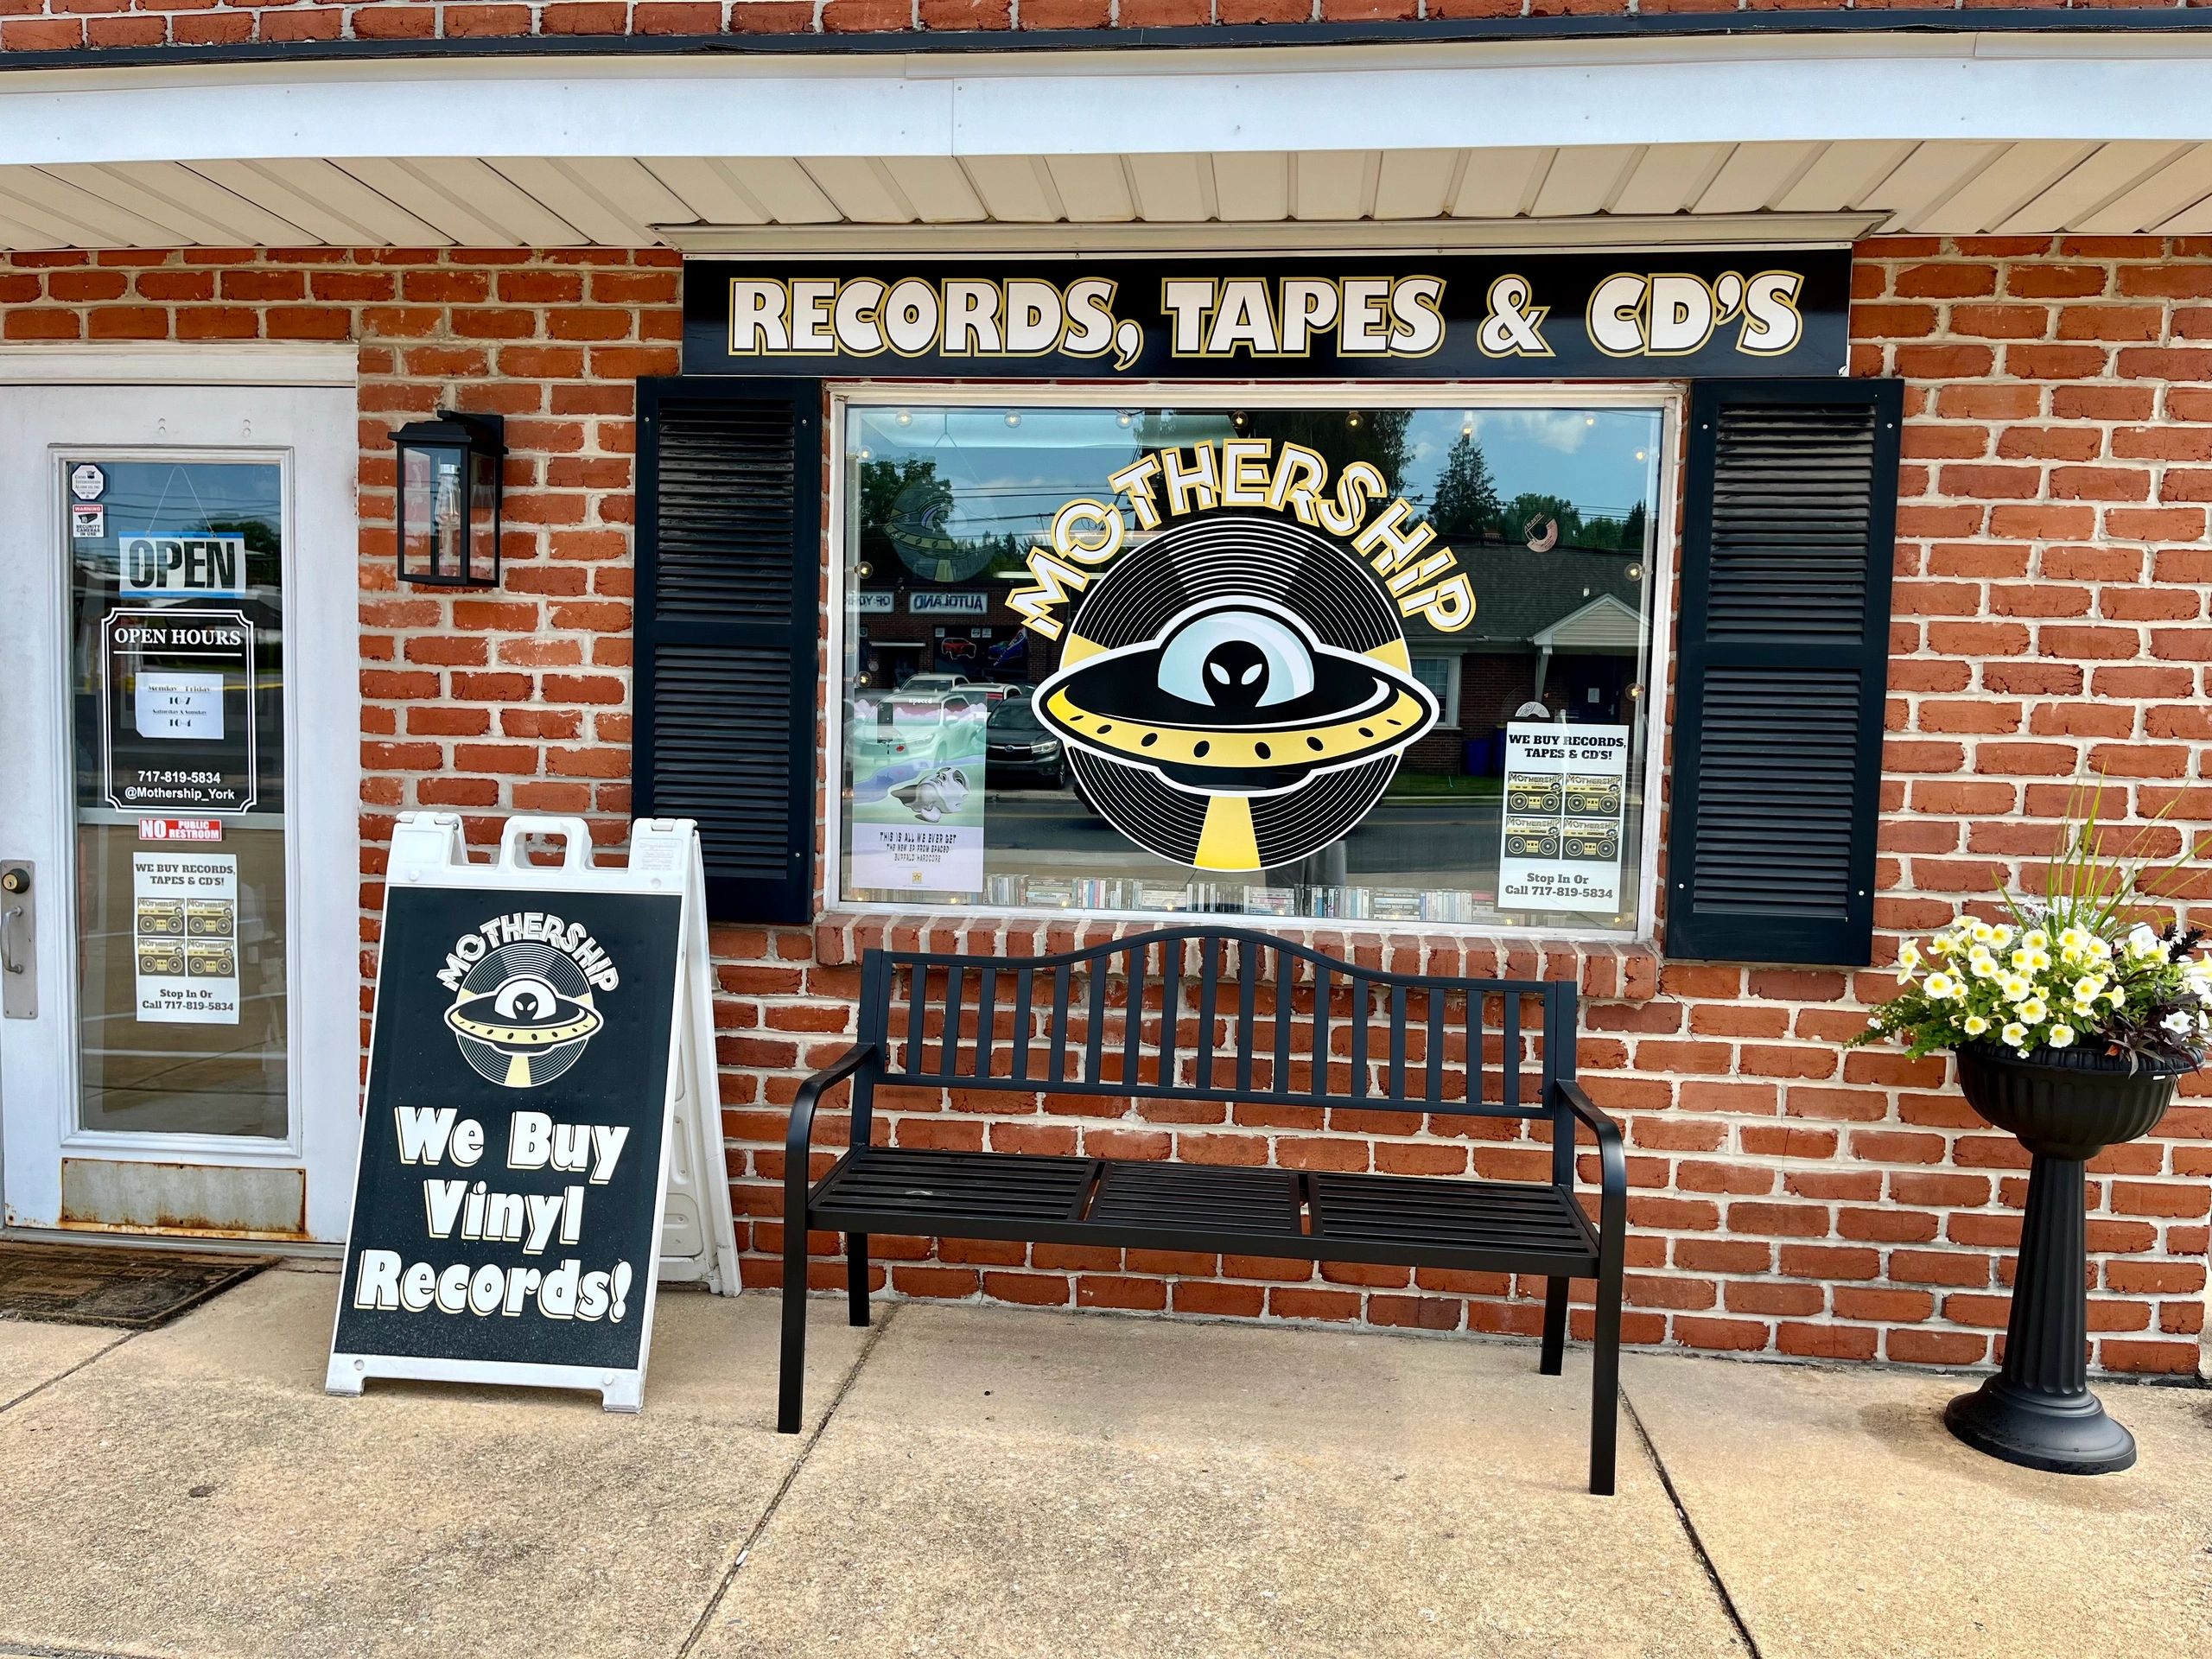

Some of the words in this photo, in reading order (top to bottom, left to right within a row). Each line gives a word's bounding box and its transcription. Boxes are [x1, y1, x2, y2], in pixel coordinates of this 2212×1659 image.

[728, 276, 1142, 372] RECORDS,
[1161, 276, 1447, 359] TAPES
[1477, 273, 1556, 359] &
[1585, 270, 1806, 359] CD'S
[1004, 438, 1477, 641] MOTHERSHIP
[130, 539, 235, 588] OPEN
[115, 628, 167, 645] OPEN
[172, 629, 241, 645] HOURS
[1509, 734, 1530, 744] WE
[1534, 735, 1560, 745] BUY
[1563, 736, 1626, 748] RECORDS,
[1524, 748, 1565, 758] TAPES
[1568, 749, 1578, 759] &
[1581, 750, 1612, 760] CD'S!
[137, 771, 221, 784] 717-819-5834
[124, 786, 235, 801] @Mothership_York
[141, 820, 167, 838] NO
[178, 821, 209, 830] PUBLIC
[168, 829, 219, 839] RESTROOM
[880, 832, 893, 842] THIS
[896, 832, 902, 842] IS
[904, 832, 914, 842] ALL
[917, 833, 925, 842] WE
[928, 833, 943, 843] EVER
[945, 834, 957, 843] GET
[136, 863, 154, 873] WE
[156, 864, 179, 873] BUY
[181, 864, 235, 875] RECORDS,
[149, 875, 185, 885] TAPES
[188, 876, 195, 885] &
[198, 876, 225, 886] CD'S!
[1527, 873, 1554, 885] Stop
[1557, 874, 1571, 884] In
[1573, 874, 1589, 884] Or
[1505, 885, 1529, 895] Call
[1531, 887, 1613, 899] 717-819-5834
[436, 912, 620, 992] MOTHERSHIP
[160, 988, 183, 1000] Stop
[186, 989, 197, 998] In
[200, 989, 213, 998] Or
[142, 1000, 162, 1009] Call
[164, 1001, 234, 1011] 717-819-5834
[394, 1105, 484, 1167] We
[506, 1109, 631, 1185] Buy
[423, 1179, 585, 1255] Vinyl
[353, 1249, 633, 1324] Records!
